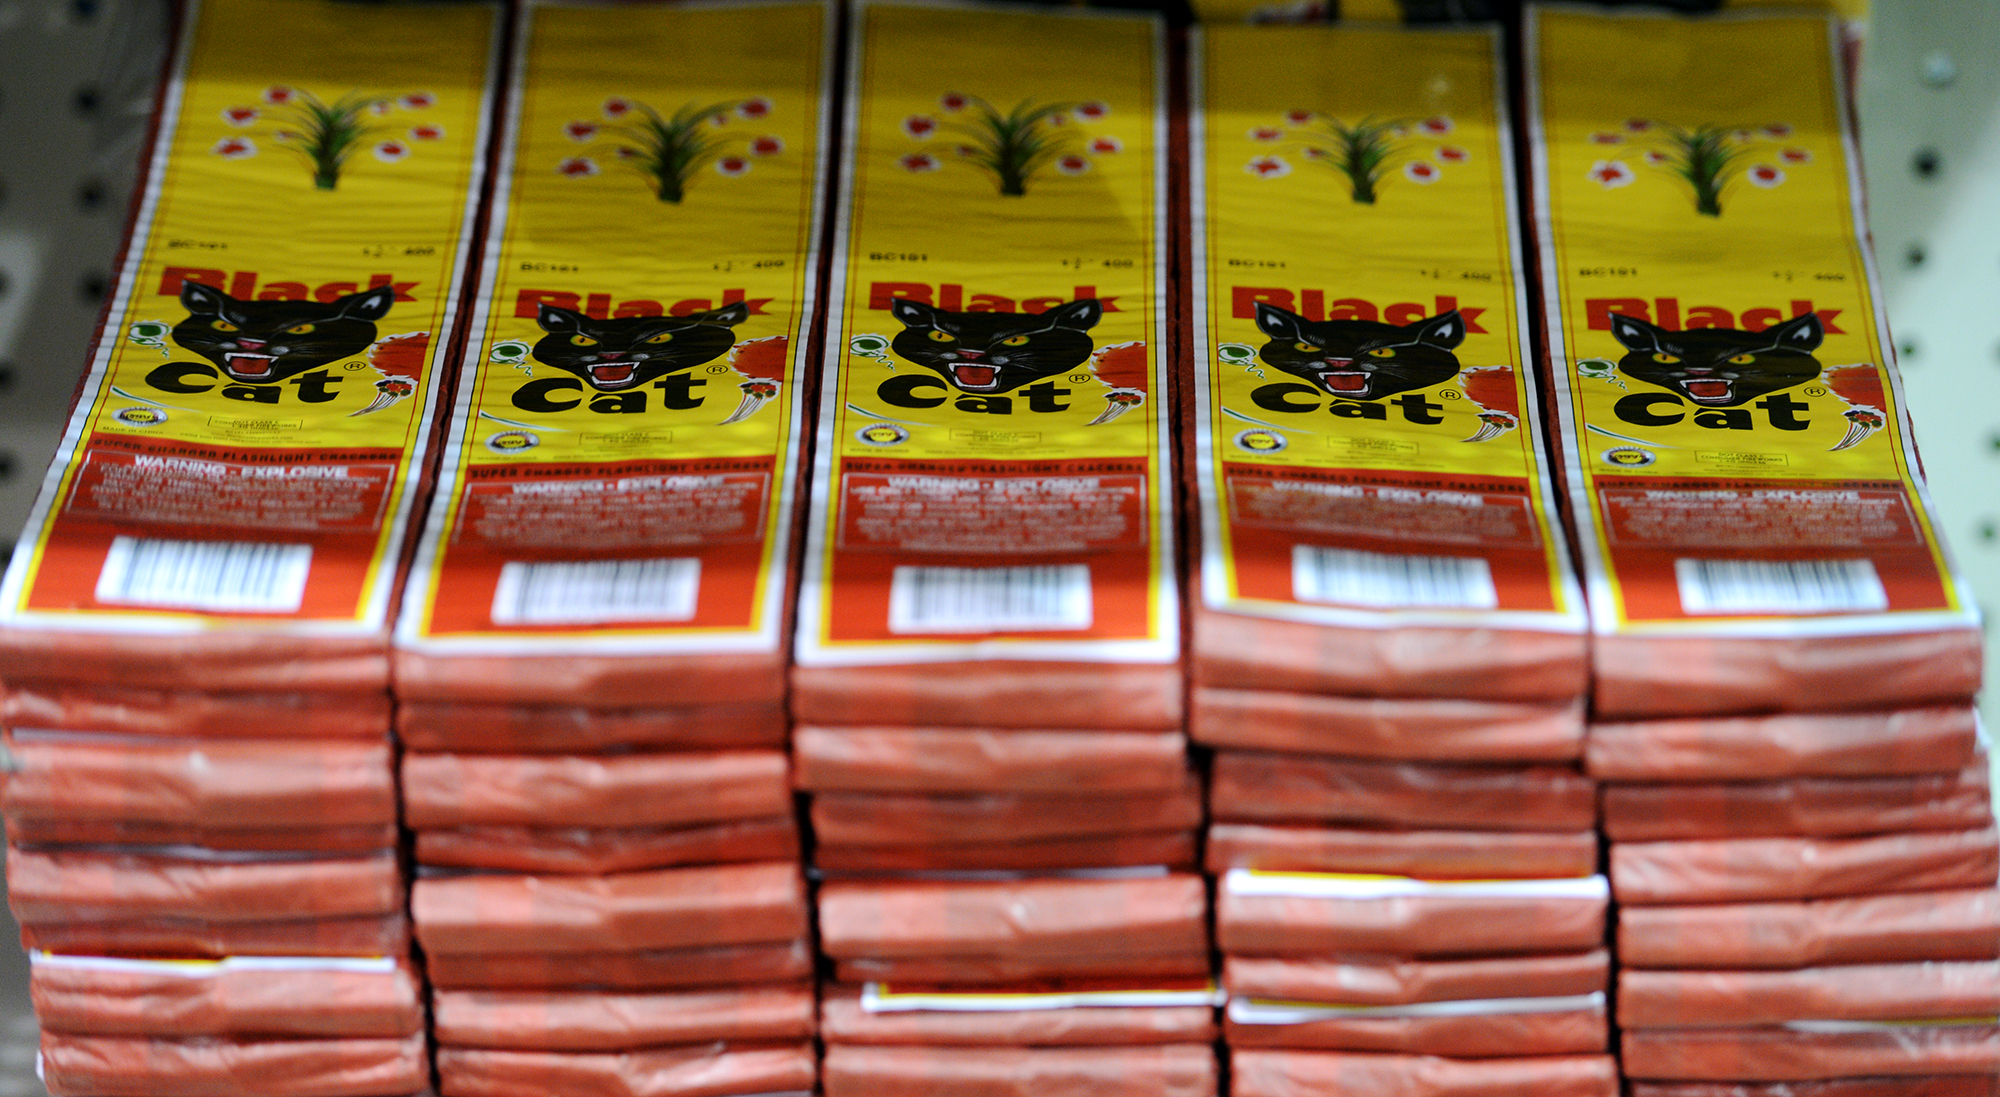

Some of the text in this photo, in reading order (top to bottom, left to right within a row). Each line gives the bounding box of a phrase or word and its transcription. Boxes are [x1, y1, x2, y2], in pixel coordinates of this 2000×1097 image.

[158, 266, 419, 302] Black
[868, 281, 1127, 315] Black
[515, 289, 775, 319] Black
[1231, 286, 1490, 335] Black
[1585, 297, 1847, 335] Black
[145, 361, 344, 404] Cat
[511, 372, 707, 414] Cat
[877, 374, 1072, 415] Cat
[1250, 382, 1444, 425] Cat
[1613, 392, 1811, 431] Cat
[134, 454, 227, 475] WARNING
[241, 465, 348, 478] EXPLOSIVE
[1646, 490, 1738, 500] WARNING
[1752, 490, 1859, 500] EXPLOSIVE
